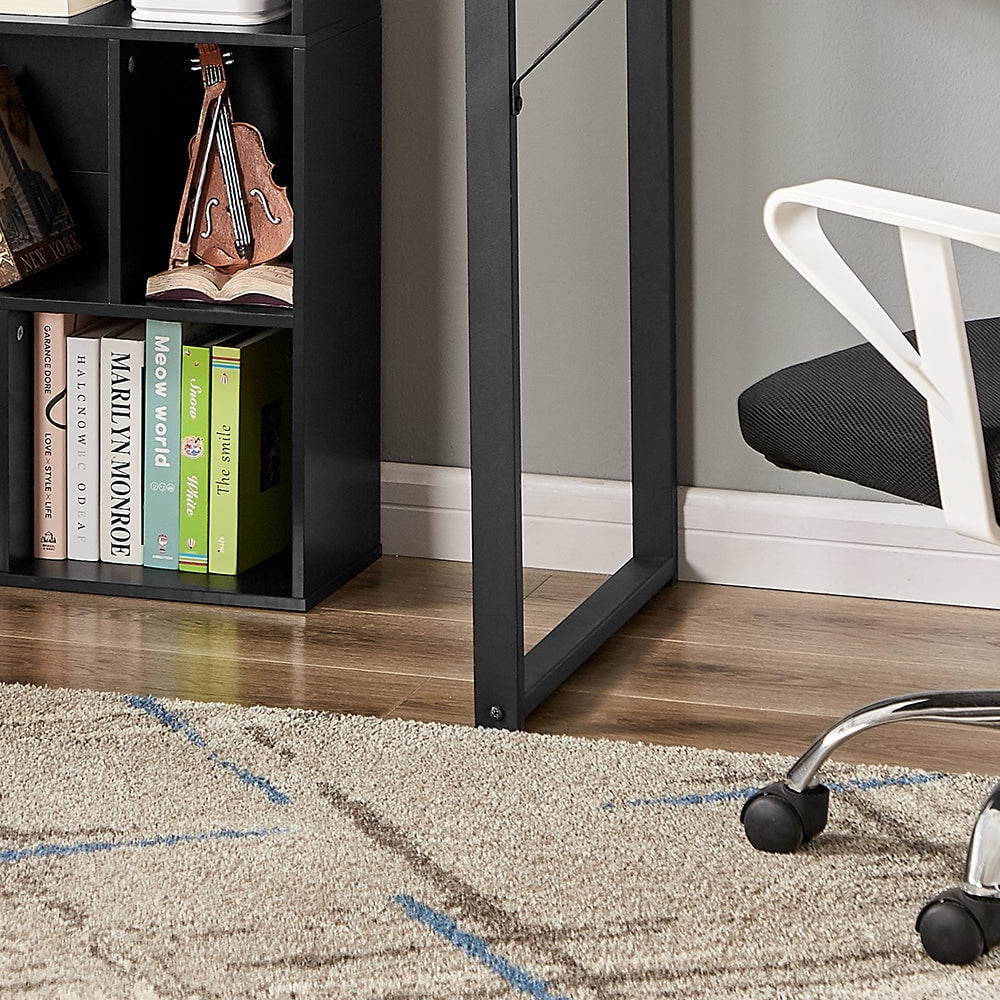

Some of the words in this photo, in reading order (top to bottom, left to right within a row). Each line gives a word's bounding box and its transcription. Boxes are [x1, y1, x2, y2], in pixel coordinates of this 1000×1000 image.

[20, 247, 47, 272] NEW
[48, 232, 82, 259] YORK
[154, 335, 170, 398] Meow
[110, 352, 131, 455] MARILYN
[189, 377, 202, 420] Snow
[44, 433, 52, 456] LOVE
[154, 405, 171, 468] world
[216, 424, 232, 463] smile
[186, 475, 199, 516] White
[216, 465, 230, 496] The
[110, 456, 131, 557] MONROE
